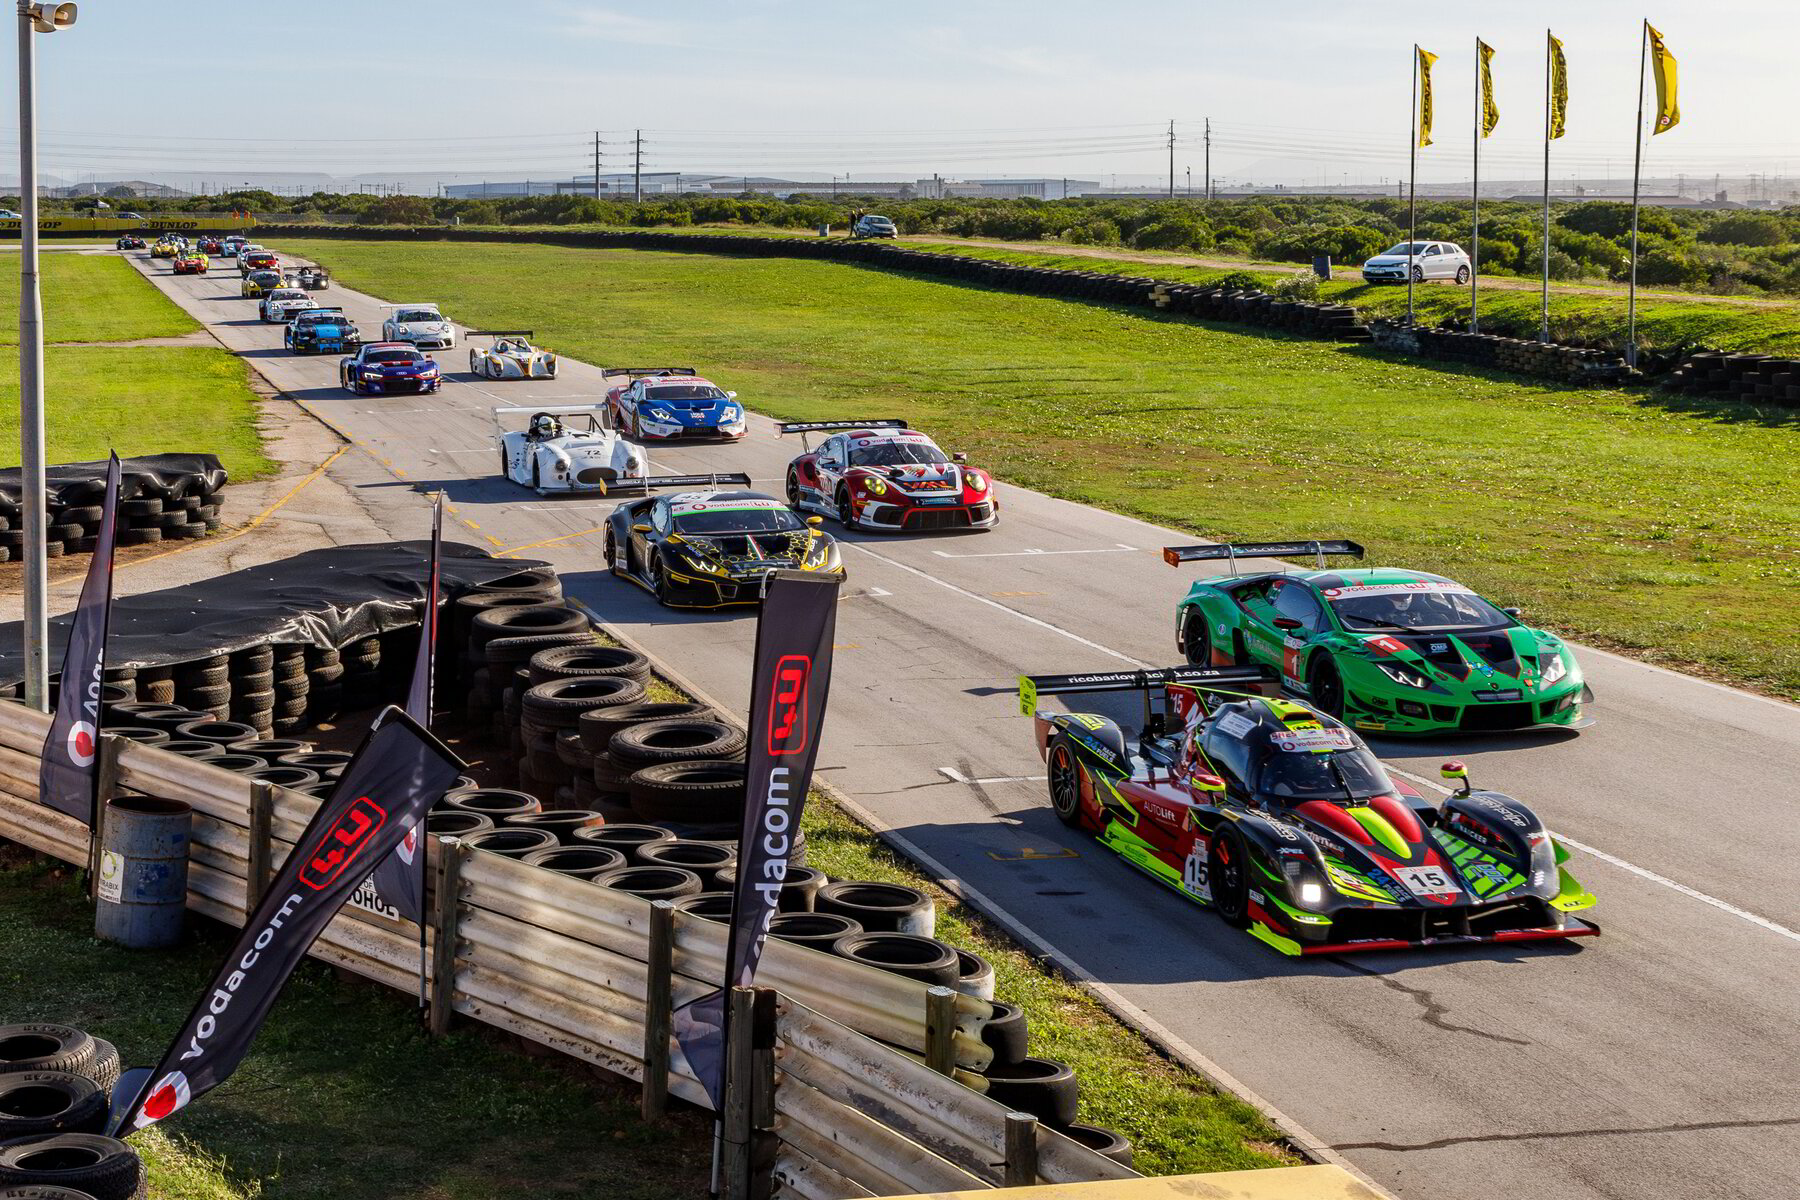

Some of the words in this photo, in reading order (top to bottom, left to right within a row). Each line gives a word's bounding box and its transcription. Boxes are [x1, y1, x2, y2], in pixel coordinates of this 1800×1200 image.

[786, 421, 889, 430] STRADALE
[1343, 583, 1399, 593] vodacom
[1188, 857, 1209, 886] 15
[1410, 872, 1446, 888] 15
[180, 893, 303, 1061] vodacom
